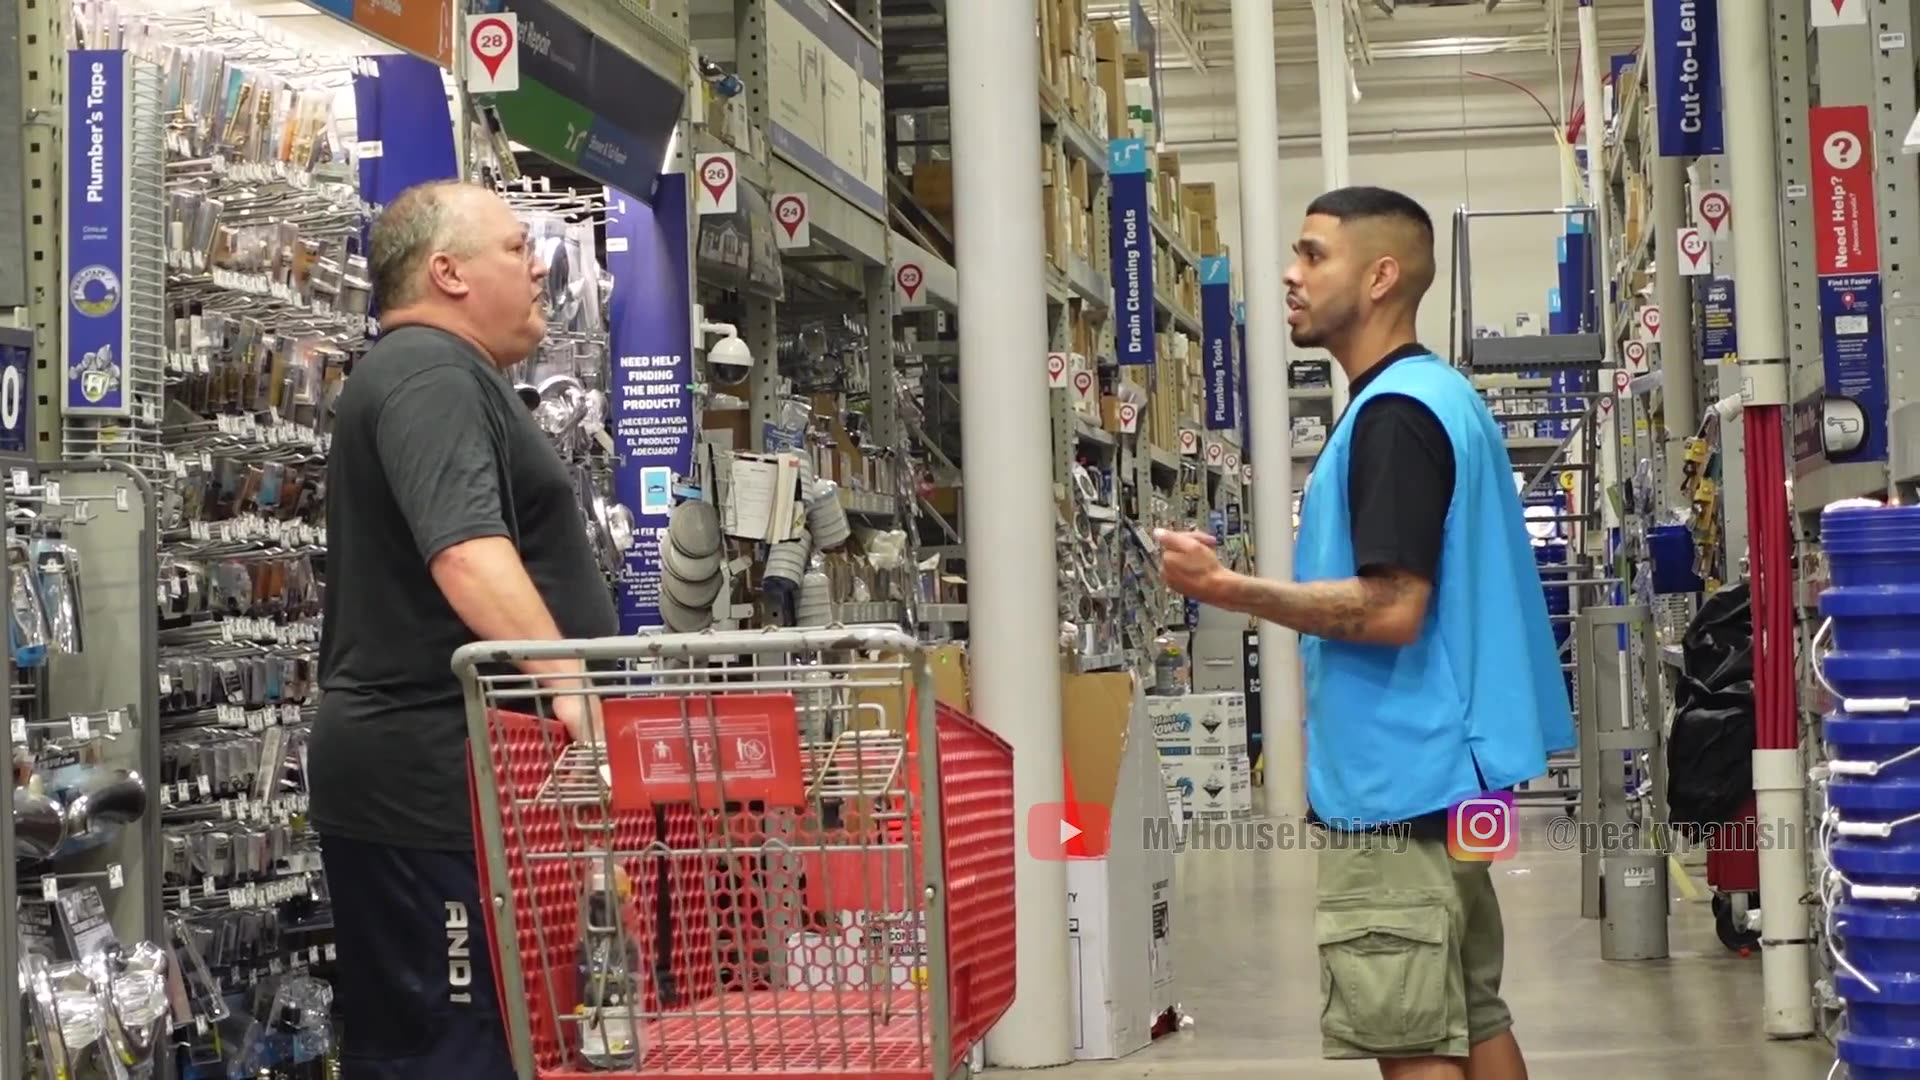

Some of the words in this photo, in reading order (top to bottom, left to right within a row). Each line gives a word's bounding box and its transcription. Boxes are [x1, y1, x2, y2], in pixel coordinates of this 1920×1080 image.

[481, 35, 503, 48] 28
[1676, 0, 1702, 133] Cut-to-Len
[87, 62, 106, 108] Tape
[86, 110, 103, 202] Plumber's
[708, 169, 726, 180] 26
[1831, 176, 1846, 221] Help?
[782, 207, 798, 217] 24
[1706, 203, 1721, 213] 23
[1123, 209, 1137, 246] Tools
[1687, 240, 1700, 248] 21
[1834, 226, 1848, 268] Need
[904, 273, 916, 282] 22
[1125, 247, 1140, 311] Cleaning
[1129, 314, 1142, 353] Drain
[1212, 338, 1223, 368] Tools
[620, 356, 649, 367] NEED
[651, 355, 681, 366] HELP
[628, 370, 673, 381] FINDING
[622, 385, 645, 396] THE
[646, 384, 681, 395] RIGHT
[1213, 370, 1226, 421] Plumbing
[623, 398, 681, 410] PRODUCT?
[618, 417, 660, 427] ¿NECESITA
[661, 416, 687, 425] AYUDA
[618, 428, 640, 436] PARA
[640, 426, 688, 435] ENCONTRAR
[626, 438, 637, 446] EL
[638, 437, 681, 445] PRODUCTO
[631, 447, 678, 456] ADECUADO?
